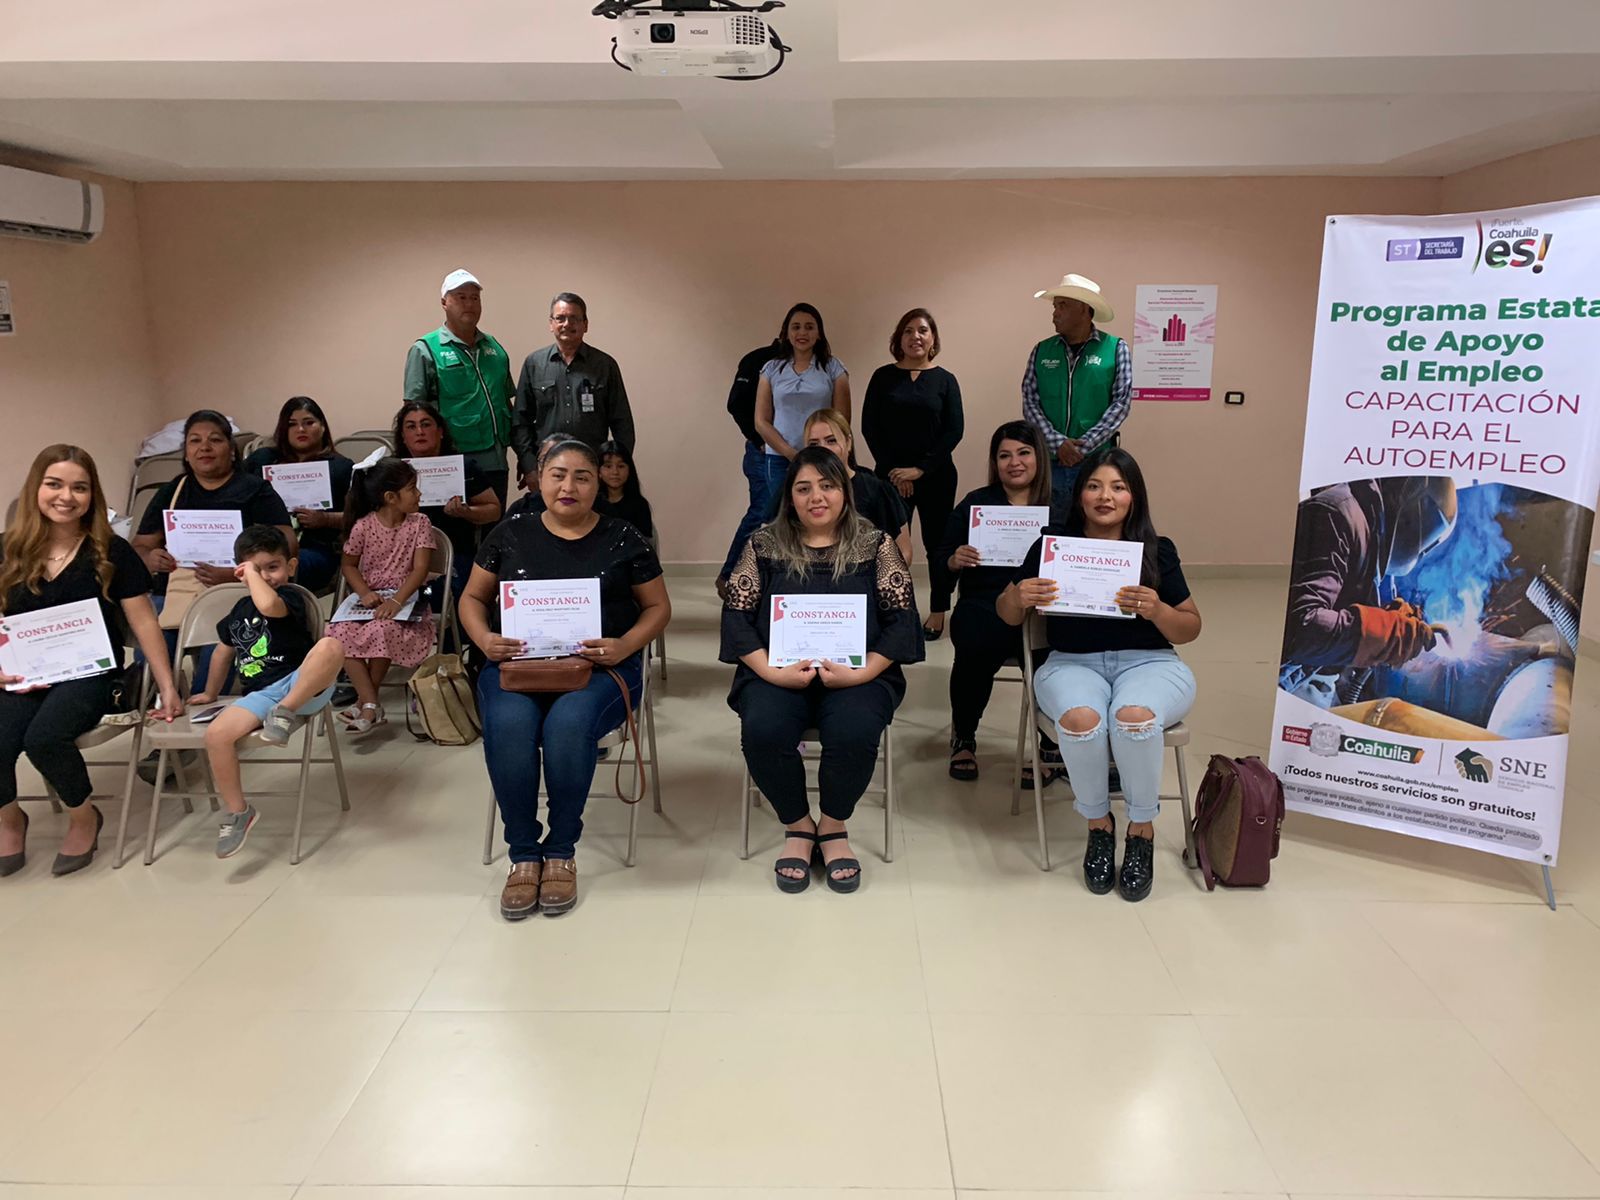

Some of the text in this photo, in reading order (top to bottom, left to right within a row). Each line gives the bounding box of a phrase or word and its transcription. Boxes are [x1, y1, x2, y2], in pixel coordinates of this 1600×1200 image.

[1489, 227, 1539, 239] Coahuila
[1394, 244, 1411, 256] ST
[1435, 247, 1458, 255] TRABAJO
[1330, 302, 1487, 327] Programa
[1387, 330, 1544, 356] de Apoyo
[1380, 360, 1544, 387] al Empleo
[1345, 389, 1580, 415] CAPACITACIÓN
[1391, 420, 1521, 443] PARA EL
[1344, 446, 1566, 474] AUTOEMPLEO
[277, 472, 323, 481] CONSTANCIA
[986, 519, 1040, 527] CONSTANCIA
[1061, 554, 1131, 567] CONSTANCIA
[521, 596, 591, 606] CONSTANCIA
[791, 611, 857, 619] CONSTANCIA
[16, 617, 93, 640] CONSTANCIA
[1343, 738, 1411, 762] Coahuila
[1499, 757, 1547, 779] SNE
[1283, 765, 1537, 821] ¡Todos nuestros servicios son gratuitos!
